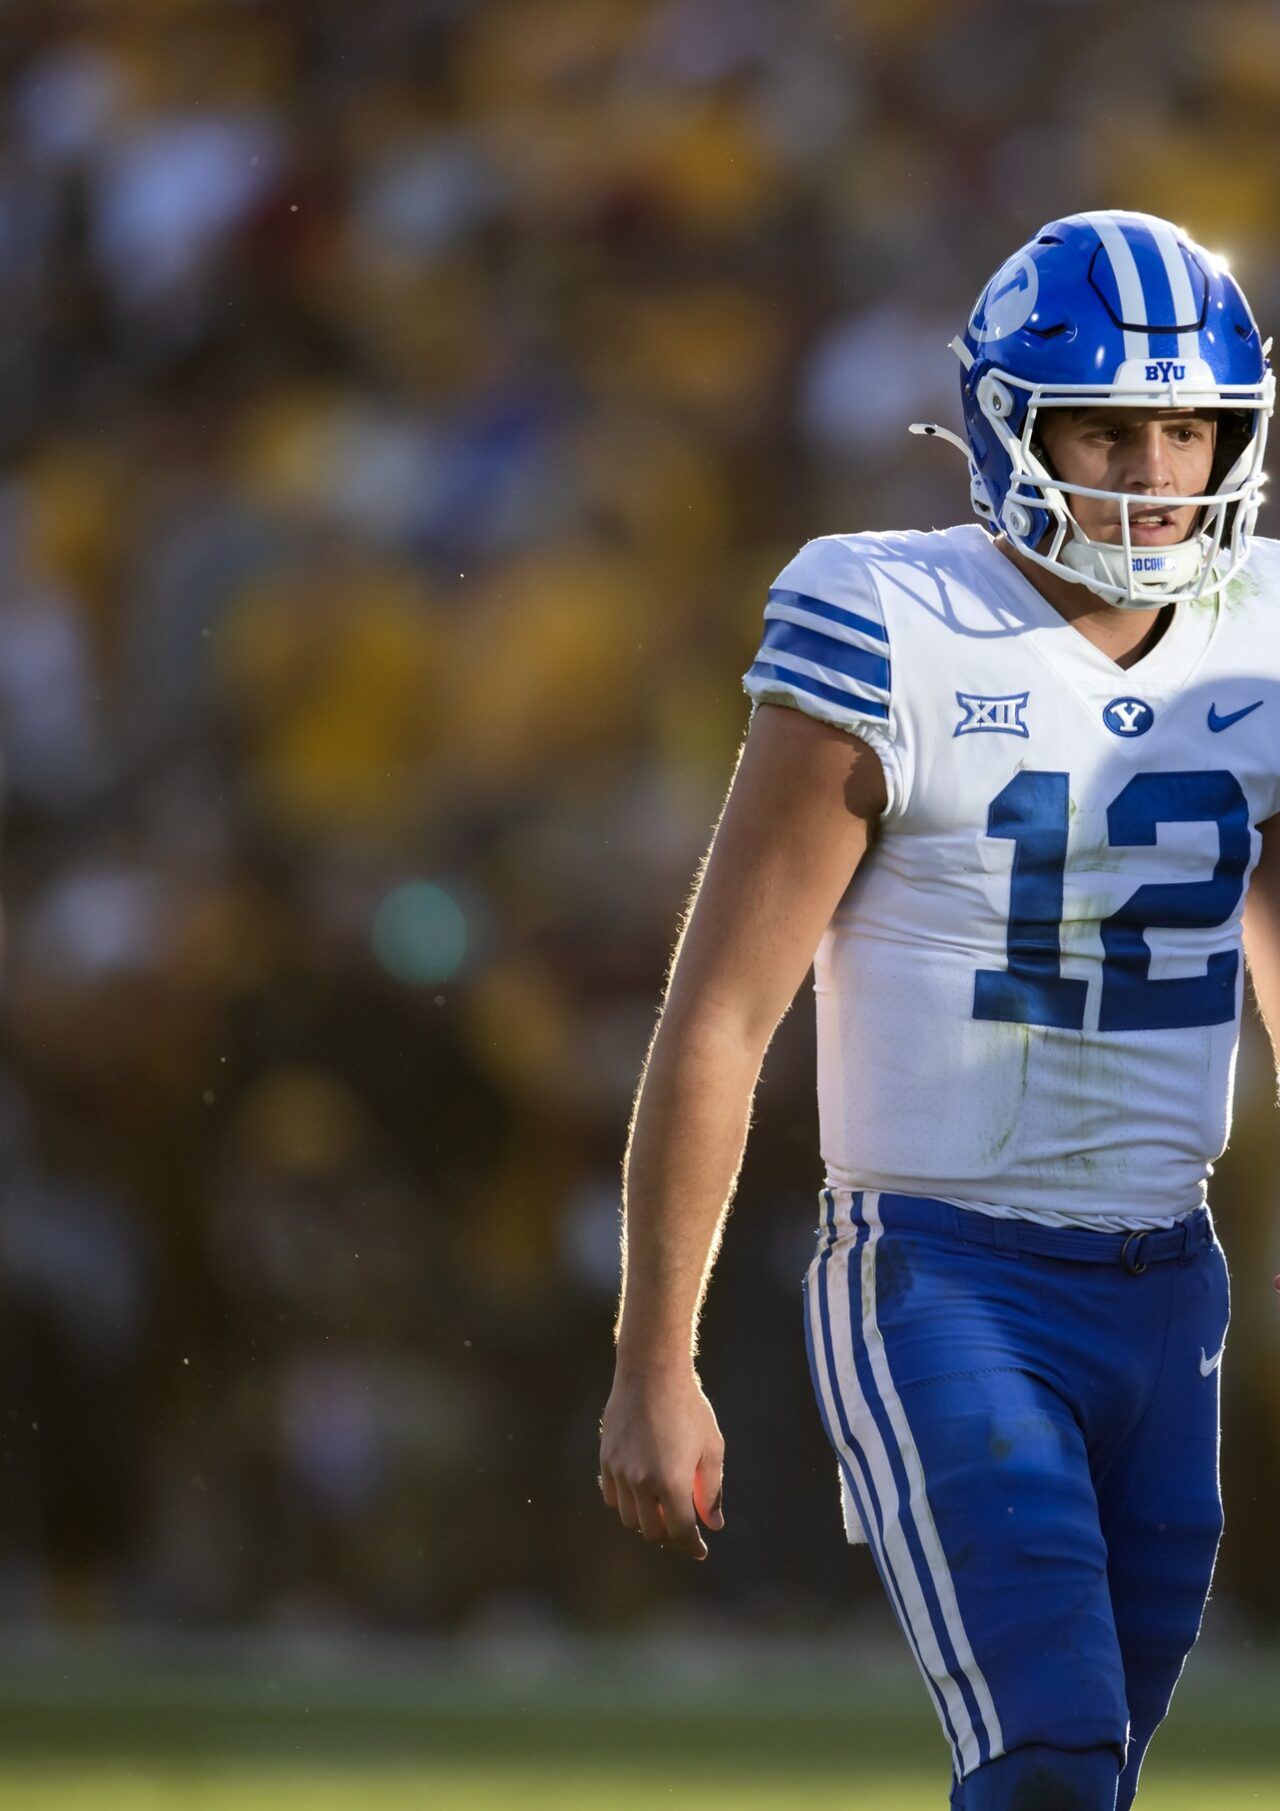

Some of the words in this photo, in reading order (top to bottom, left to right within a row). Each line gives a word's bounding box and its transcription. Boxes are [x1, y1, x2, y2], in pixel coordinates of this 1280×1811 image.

[1145, 361, 1185, 383] BYU
[959, 697, 1025, 732] XII
[1110, 702, 1146, 731] Y
[972, 770, 1250, 1031] 12
